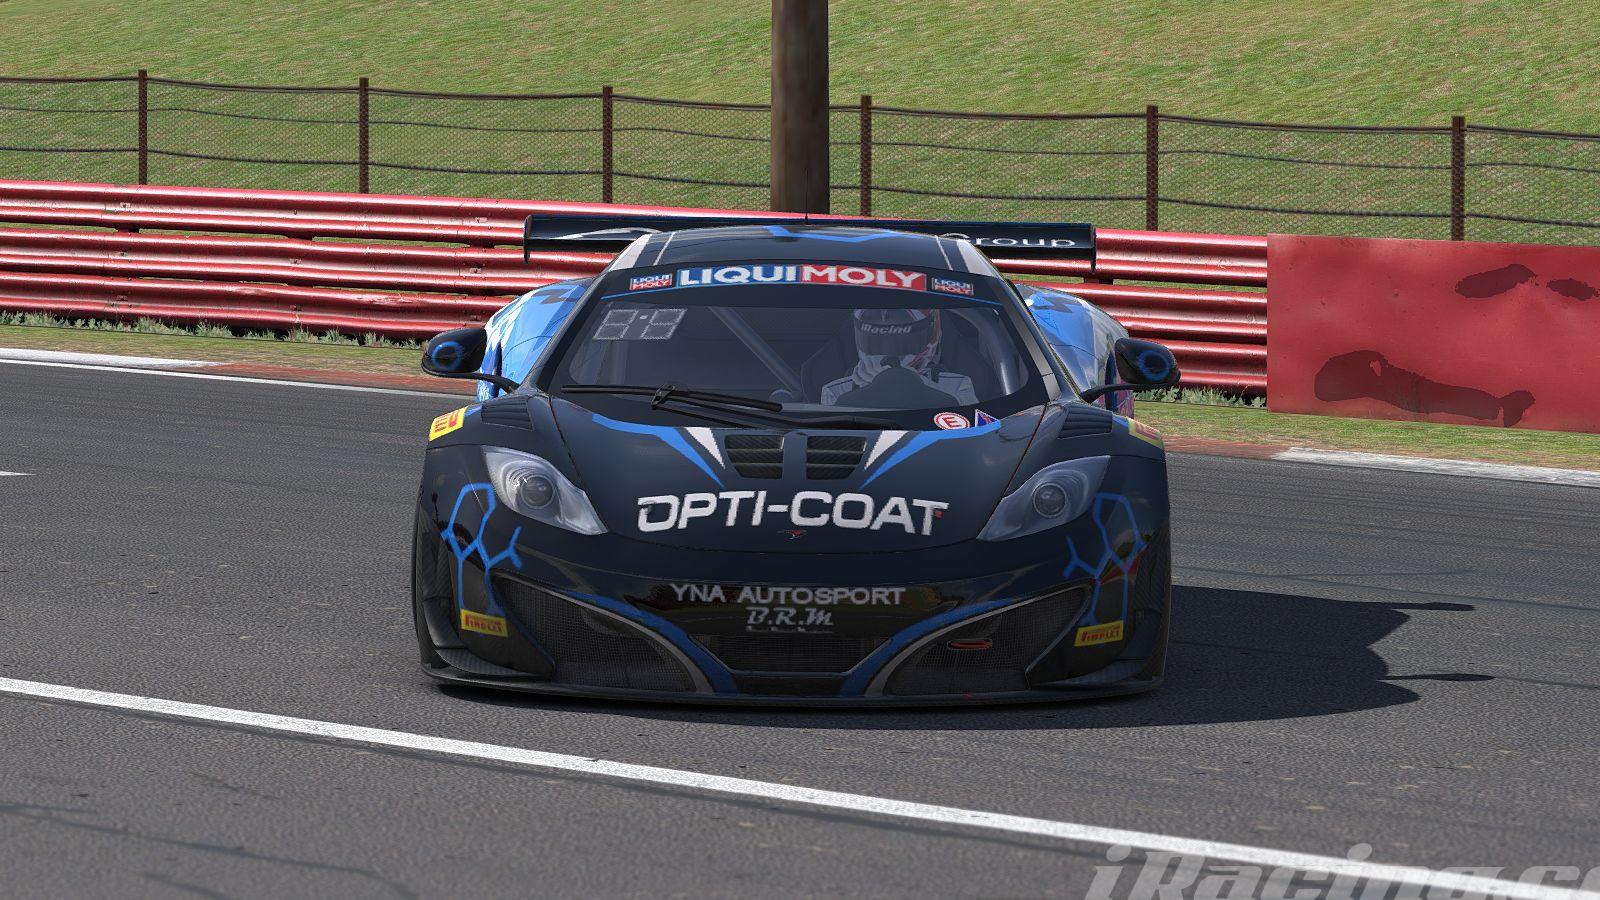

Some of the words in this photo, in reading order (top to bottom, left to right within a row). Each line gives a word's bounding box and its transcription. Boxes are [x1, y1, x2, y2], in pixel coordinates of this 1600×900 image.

[681, 265, 798, 286] LIQUI
[802, 265, 926, 288] MOLY
[637, 490, 949, 535] OPTI-COAT
[670, 584, 727, 602] YNA
[737, 586, 906, 605] AUTOSPORT
